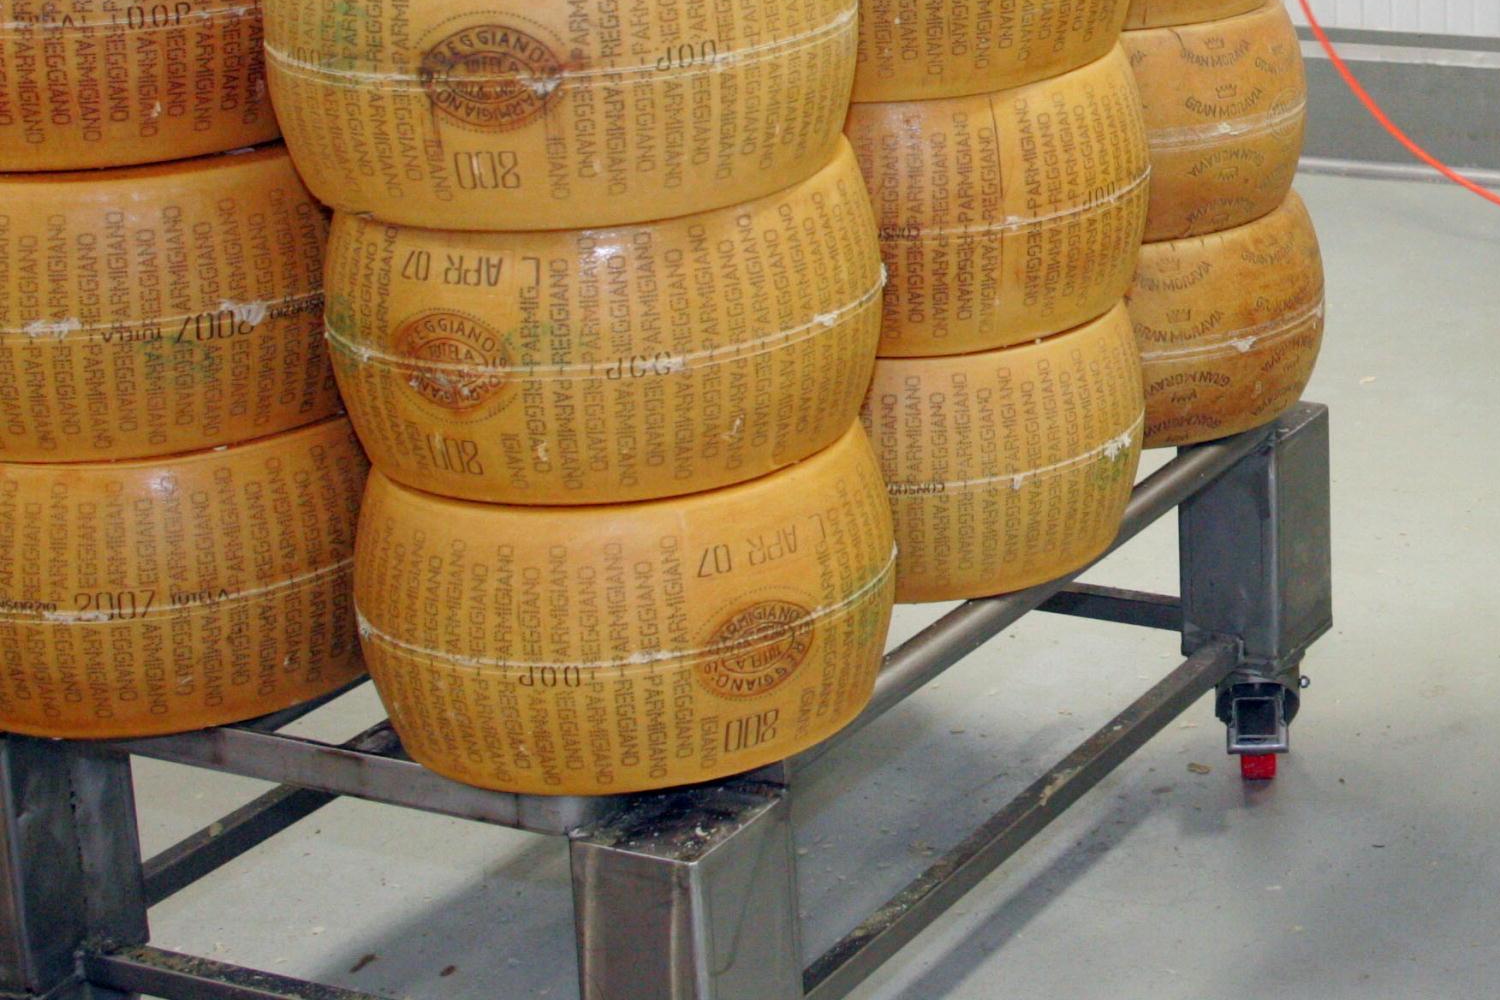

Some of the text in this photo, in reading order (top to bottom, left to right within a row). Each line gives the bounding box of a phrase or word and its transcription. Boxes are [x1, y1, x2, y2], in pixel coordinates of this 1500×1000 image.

[1185, 95, 1217, 118] GRAN
[1218, 86, 1263, 119] MORAVIA
[401, 250, 431, 281] 07
[444, 255, 503, 287] APR
[697, 544, 731, 578] 07
